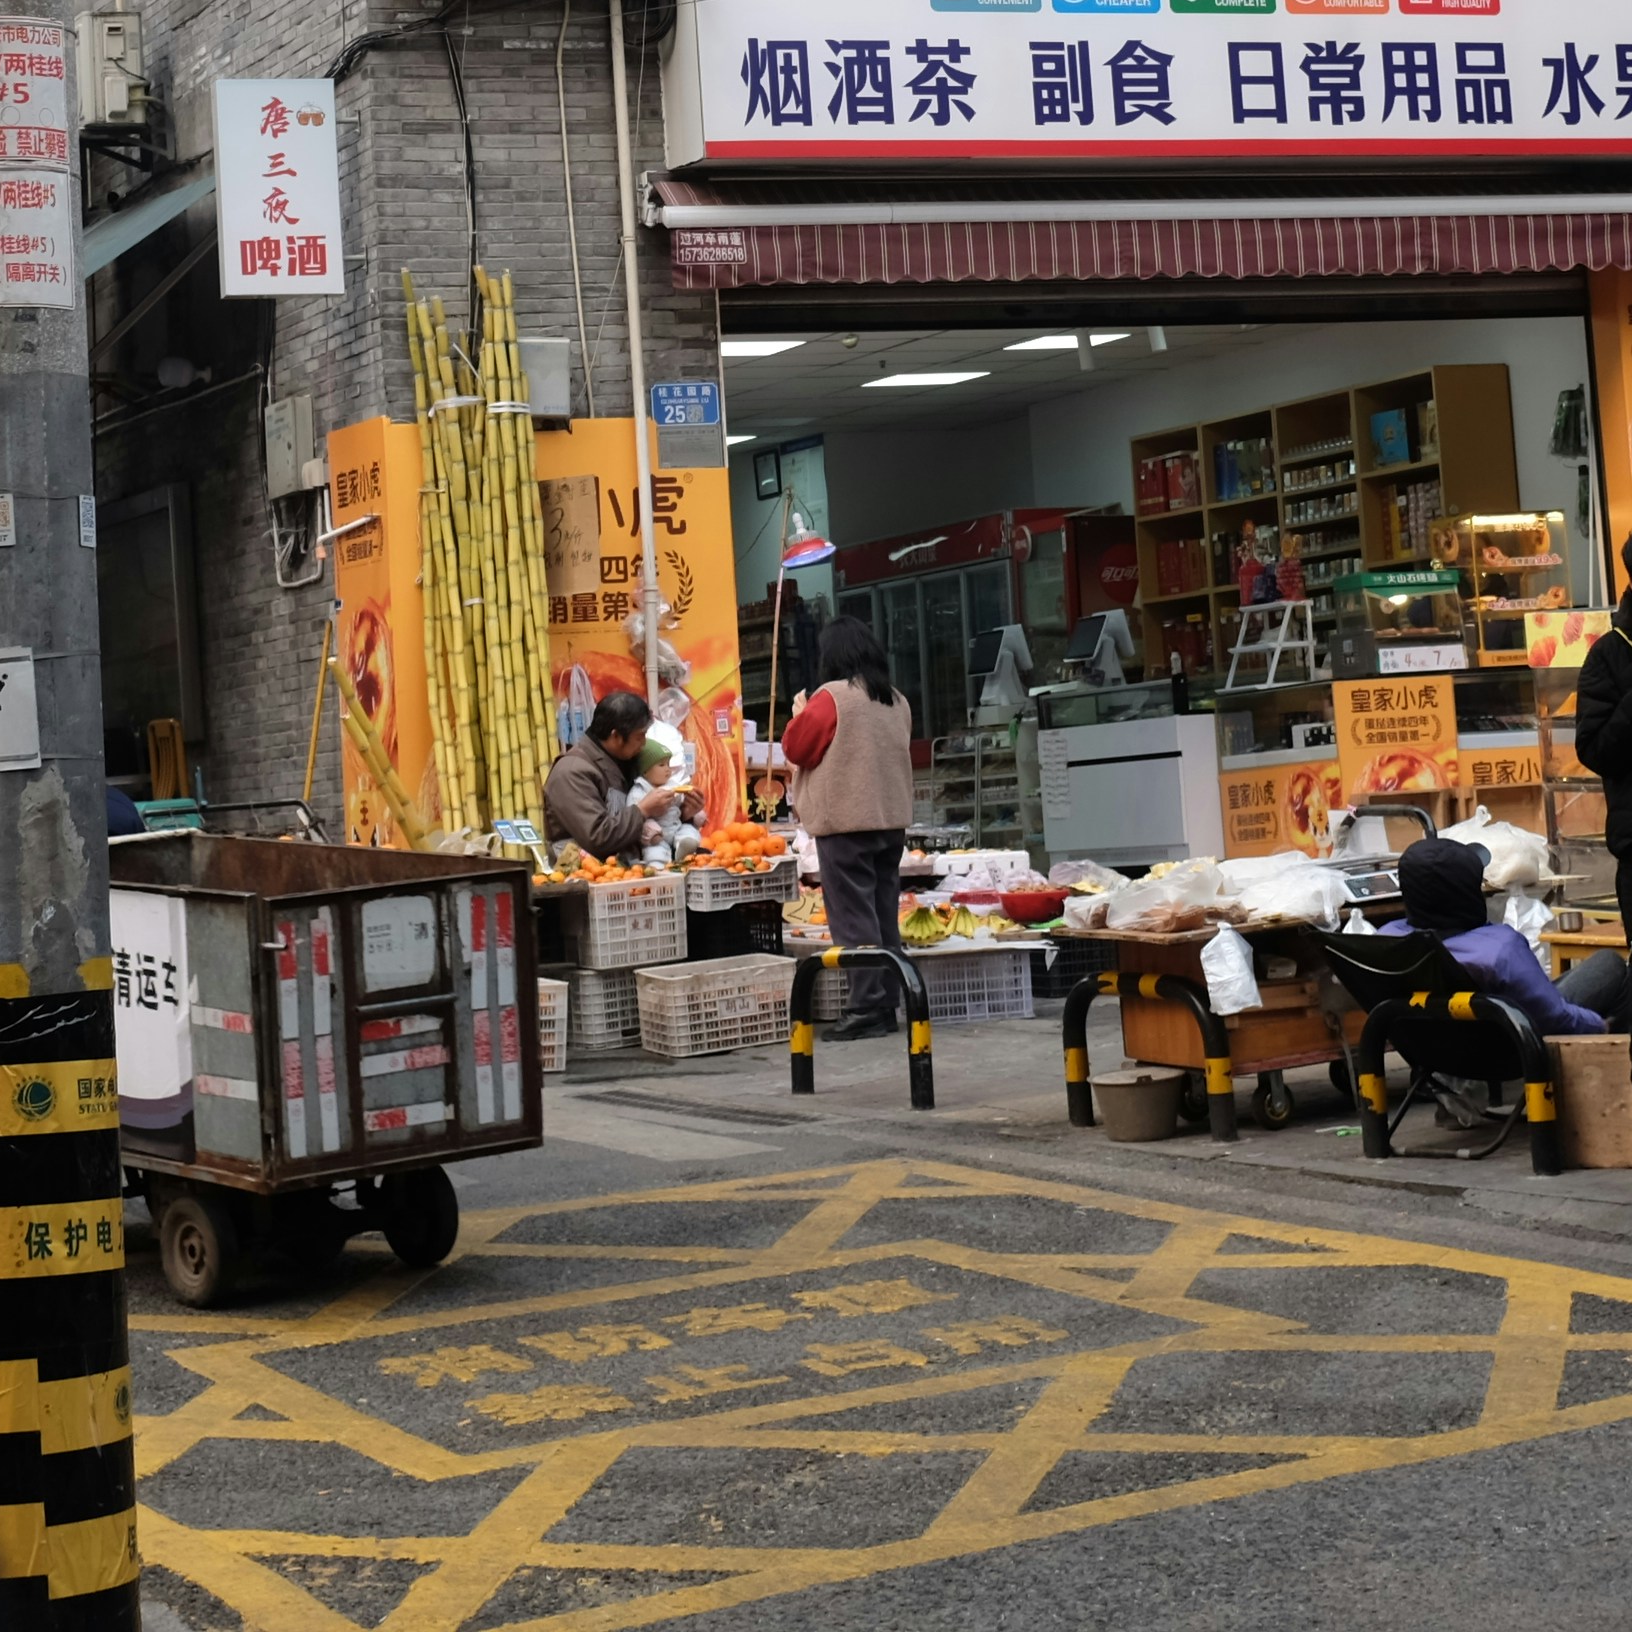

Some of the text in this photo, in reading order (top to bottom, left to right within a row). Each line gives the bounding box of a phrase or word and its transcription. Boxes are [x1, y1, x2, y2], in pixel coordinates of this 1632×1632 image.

[739, 36, 979, 129] 烟酒茶
[1028, 38, 1178, 128] 副食
[1225, 39, 1514, 128] 日常用品
[15, 129, 68, 160] 禁止攀登
[239, 234, 328, 278] 啤酒
[658, 385, 712, 398] 桂花园路
[664, 404, 687, 424] 25
[336, 461, 382, 509] 皇家小虎
[548, 591, 638, 625] 销量第
[1350, 684, 1439, 715] 皇家小虎
[1365, 730, 1431, 745] 全国销量第一
[1227, 779, 1277, 810] 皇家小虎
[24, 1215, 125, 1261] 保护电
